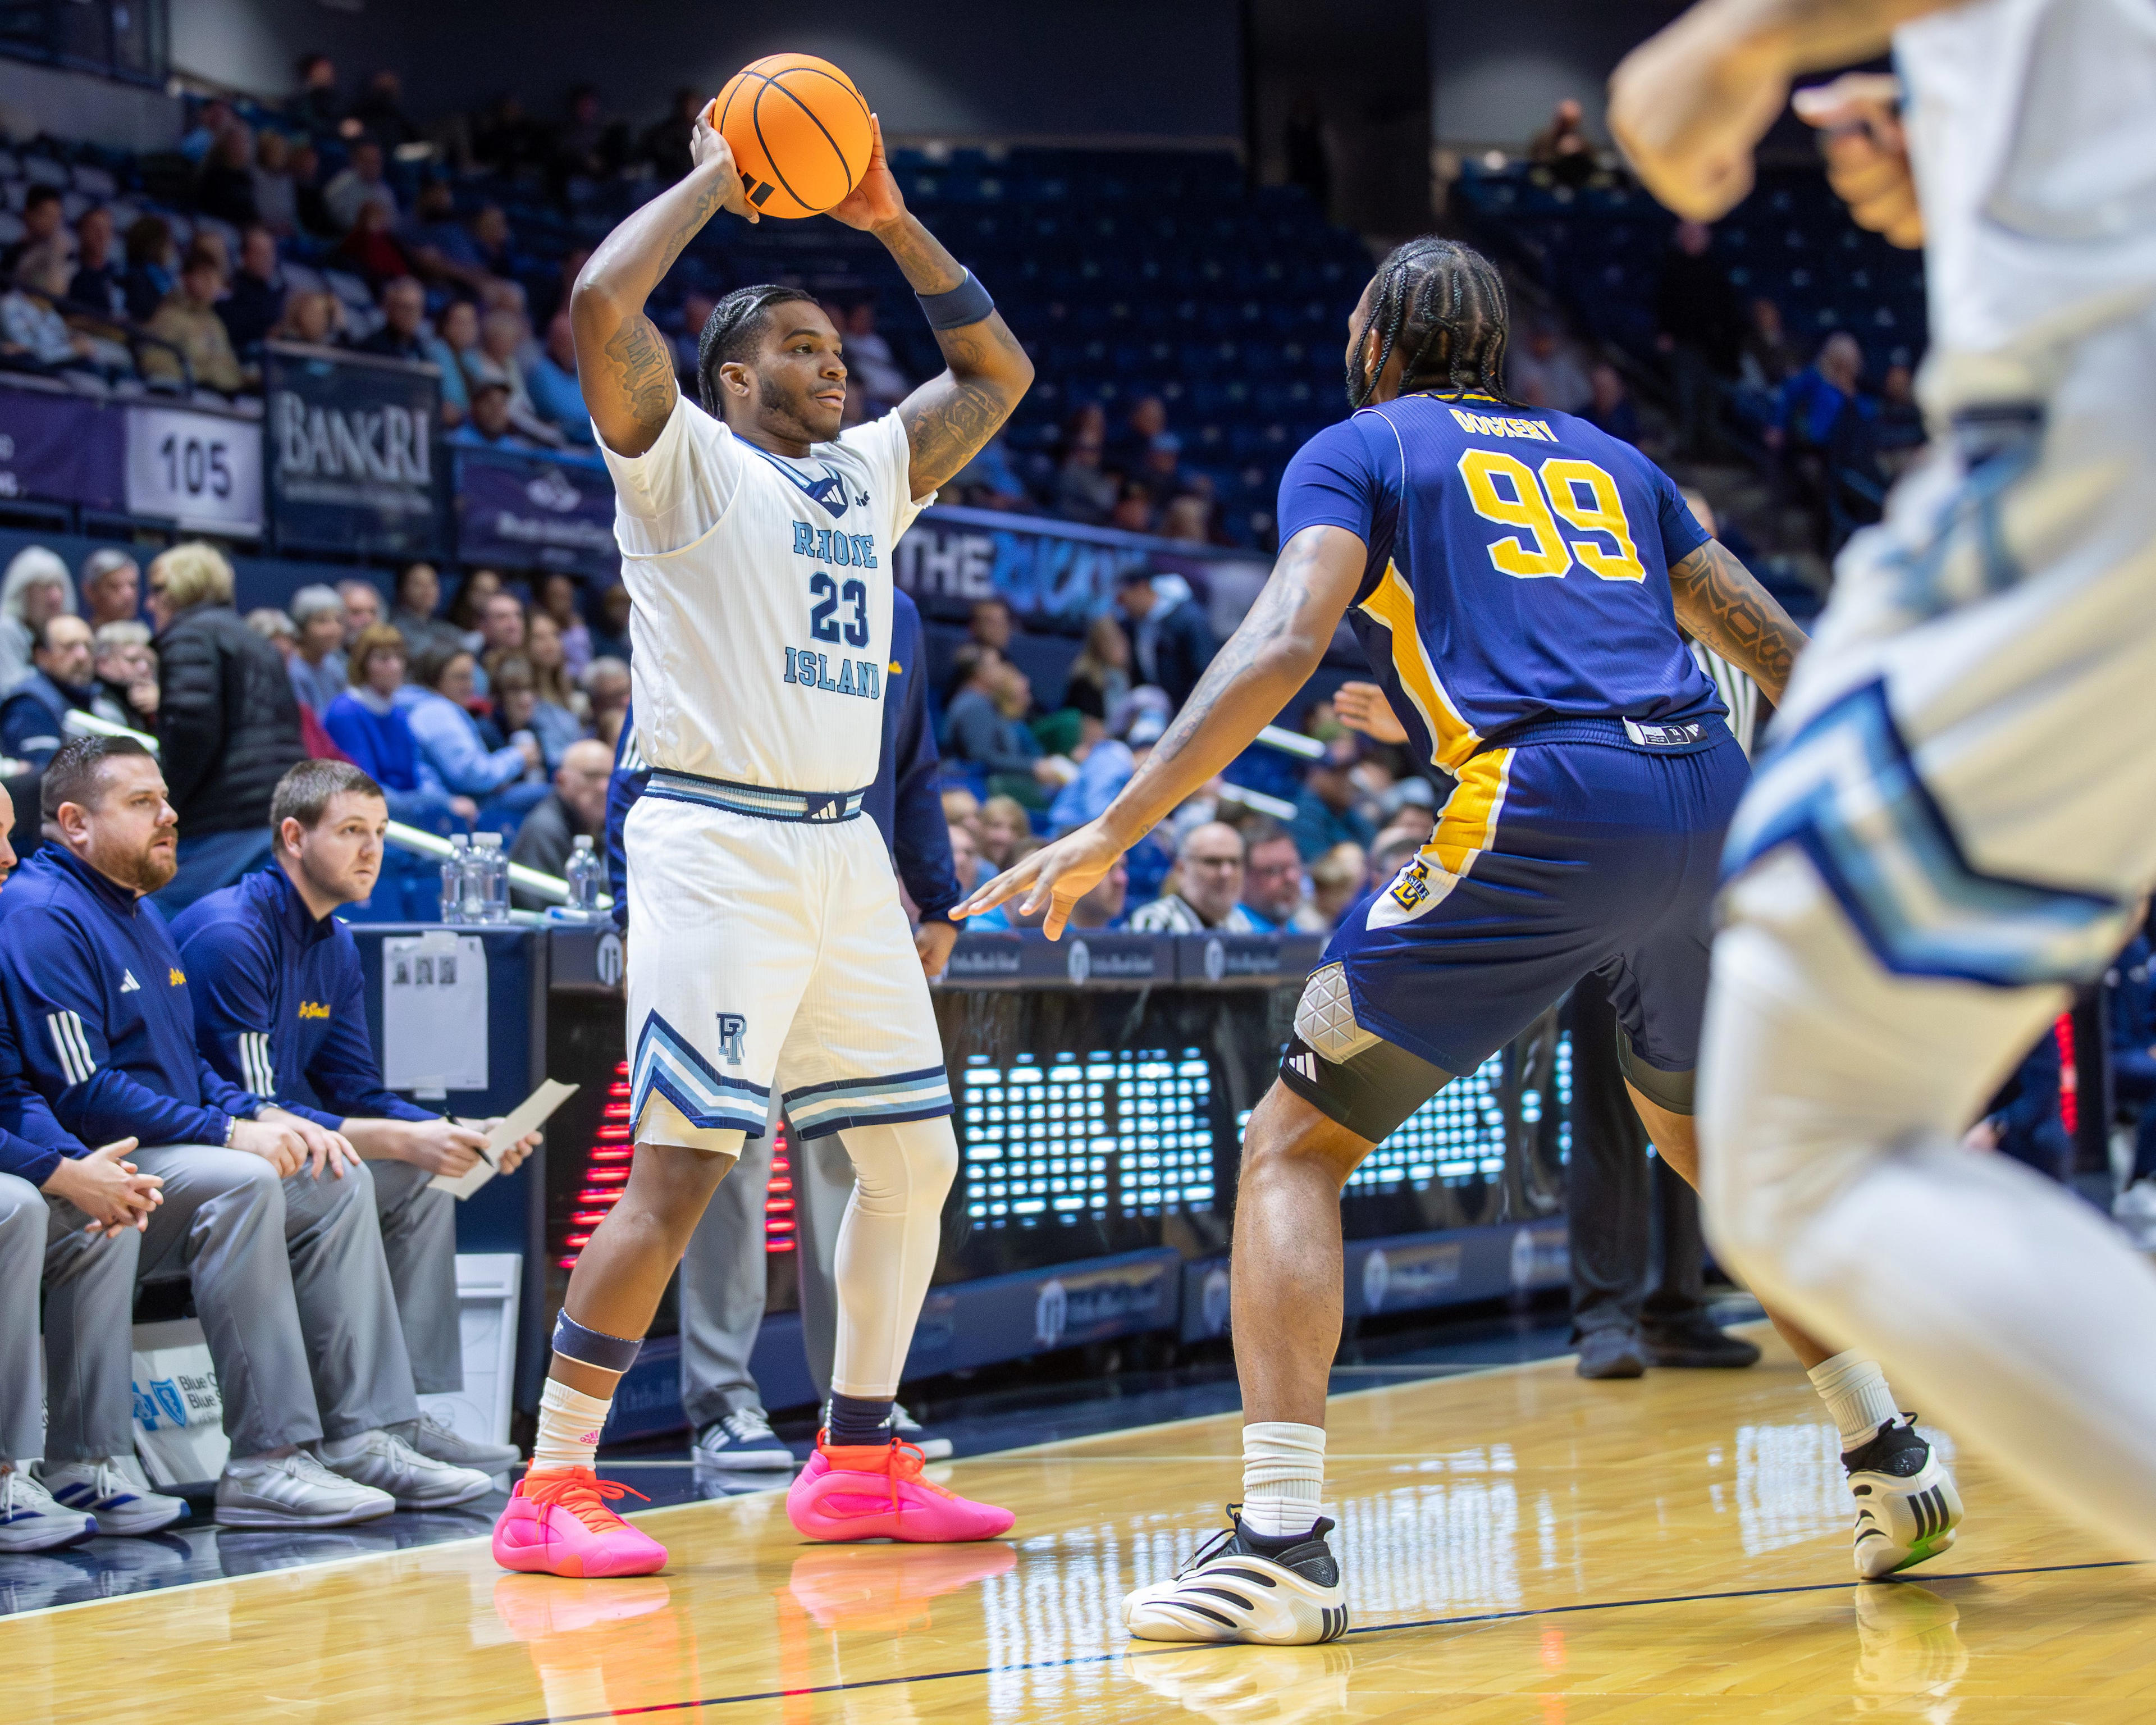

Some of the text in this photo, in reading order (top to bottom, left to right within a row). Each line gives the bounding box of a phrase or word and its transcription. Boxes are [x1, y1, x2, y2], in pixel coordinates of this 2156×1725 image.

[273, 391, 431, 484] BANKRI
[1449, 409, 1559, 442] DOCKERY
[162, 433, 232, 498] 105
[1457, 448, 1647, 584] 99
[792, 520, 878, 569] RHODE
[809, 571, 870, 649] 23
[784, 646, 880, 700] ISLAND
[178, 1375, 207, 1390] Blue
[188, 1393, 217, 1408] Blue
